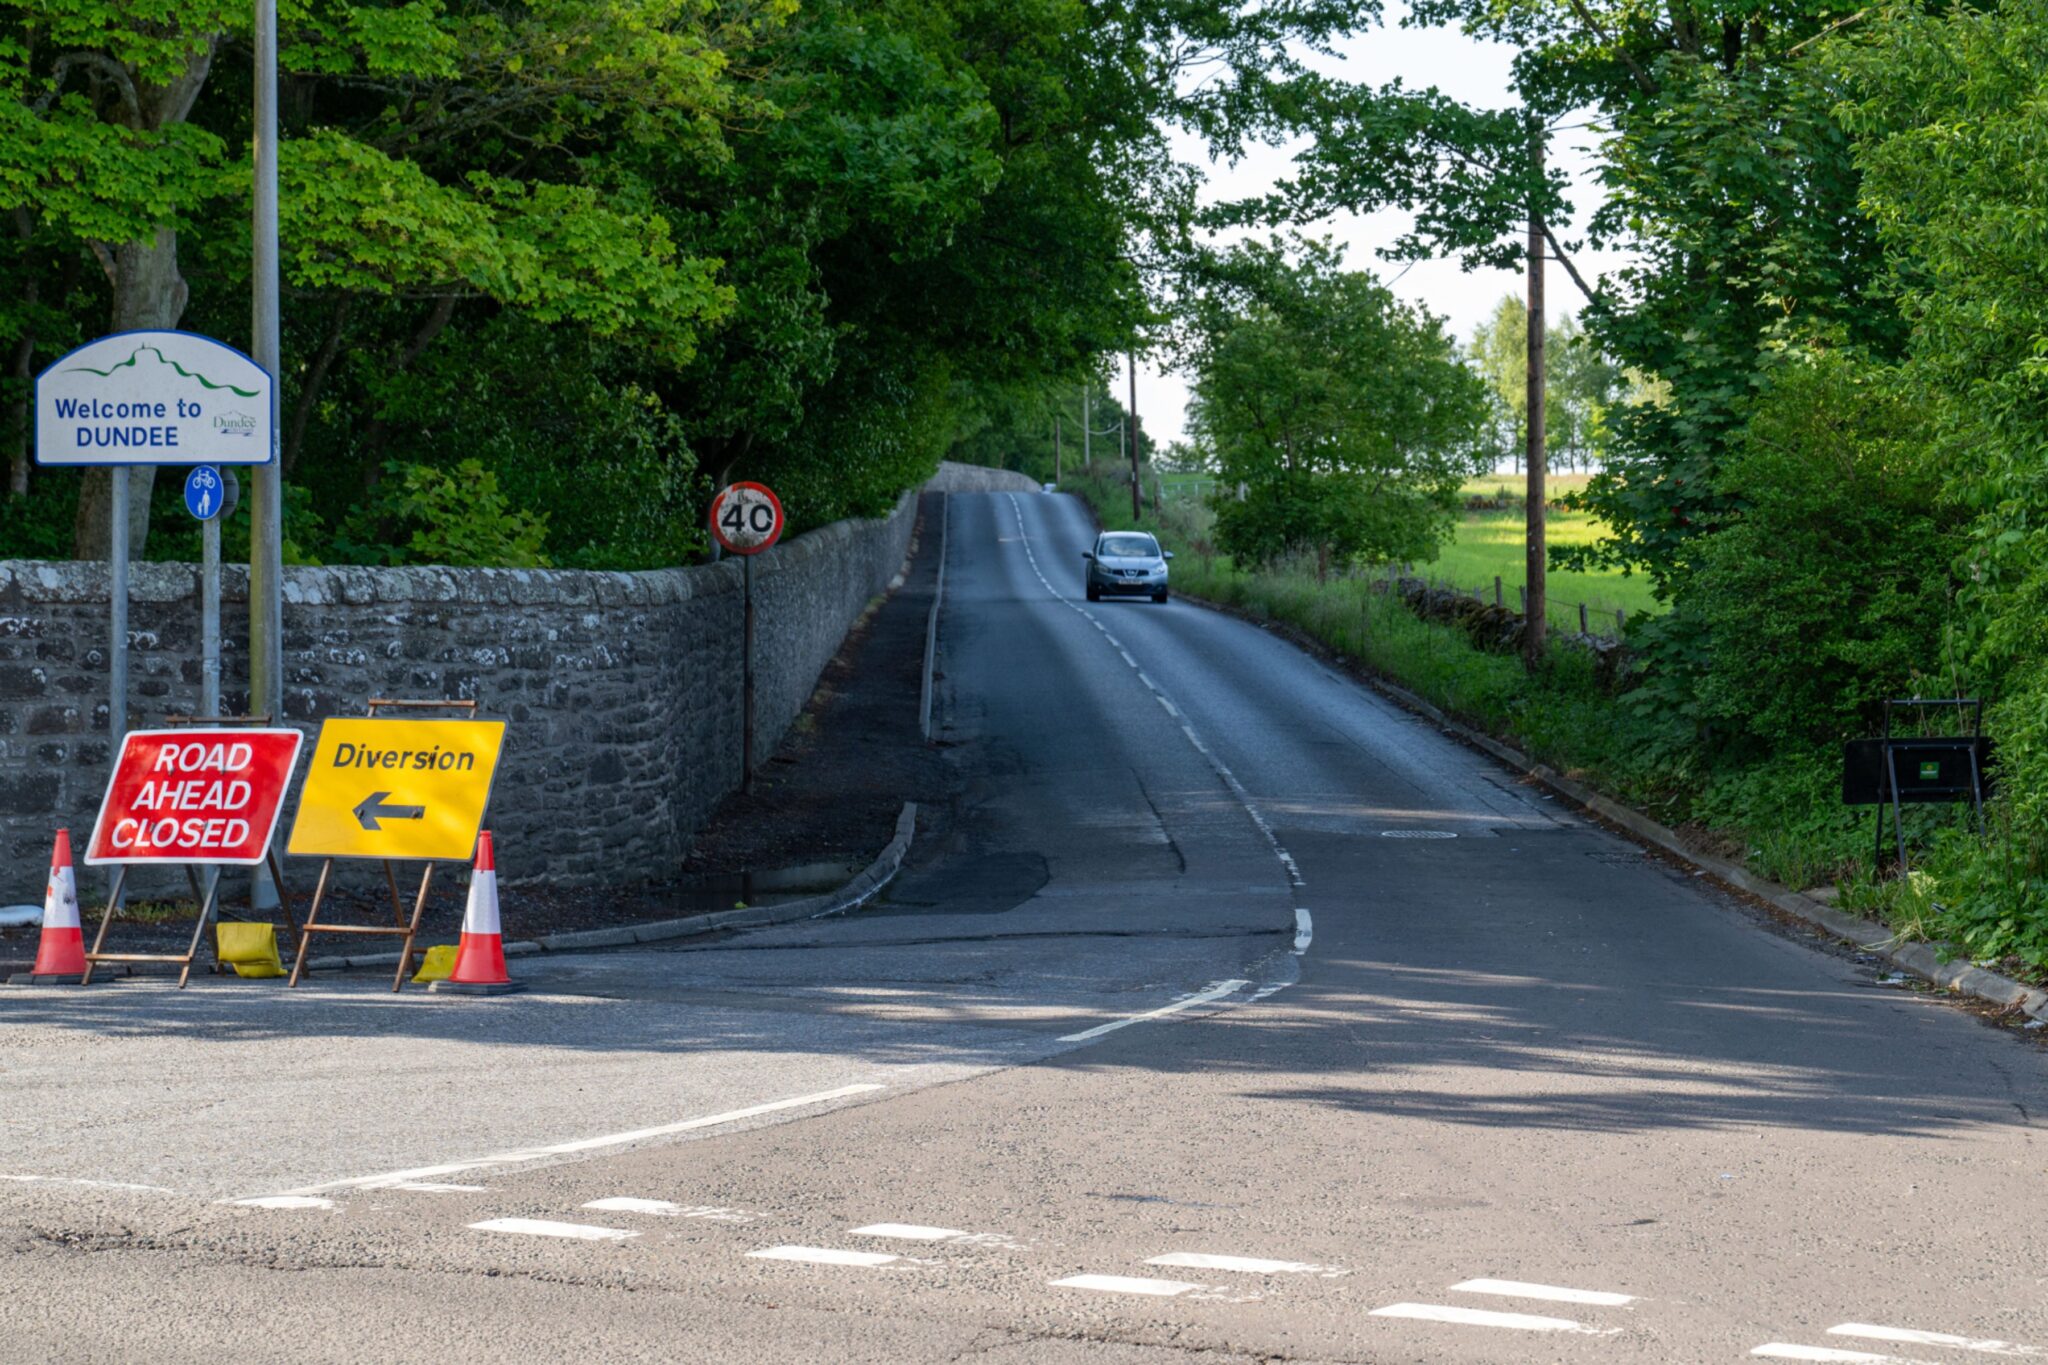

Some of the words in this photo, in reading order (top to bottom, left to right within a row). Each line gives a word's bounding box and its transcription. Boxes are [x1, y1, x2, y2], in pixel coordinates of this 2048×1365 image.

[54, 398, 166, 419] Welcome
[177, 398, 202, 418] to
[76, 427, 179, 447] DUNDEE
[721, 503, 774, 533] 40
[154, 743, 253, 772] ROAD
[333, 743, 475, 770] Diversion
[130, 780, 252, 810] AHEAD
[111, 817, 250, 848] CLOSED
